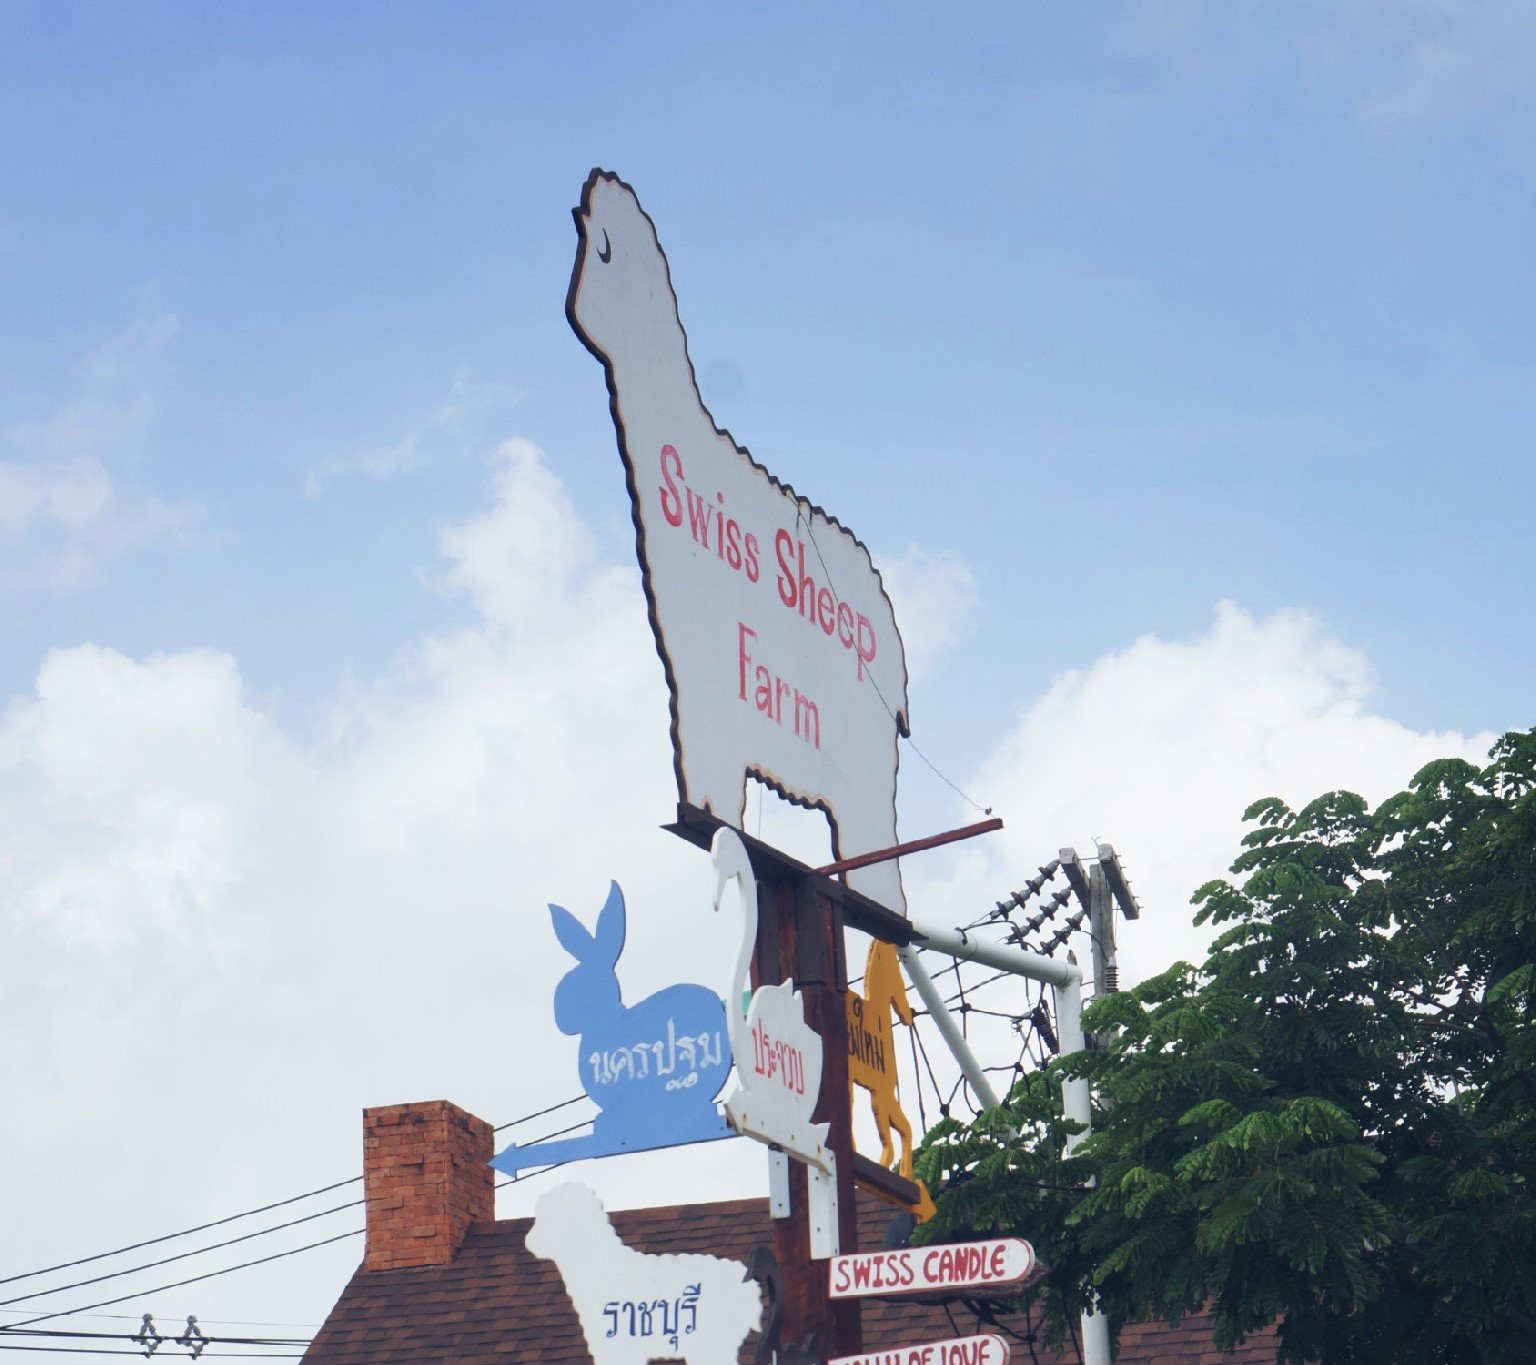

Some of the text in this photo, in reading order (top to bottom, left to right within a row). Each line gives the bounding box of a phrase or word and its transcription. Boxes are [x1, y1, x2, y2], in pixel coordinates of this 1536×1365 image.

[658, 444, 760, 583] Swiss
[737, 621, 821, 750] Farm
[588, 1015, 722, 1092] นครปฐม
[751, 1017, 805, 1095] ประจวบ
[835, 1244, 1007, 1292] SWISS CANDLE
[603, 1282, 702, 1352] ราชบุรี
